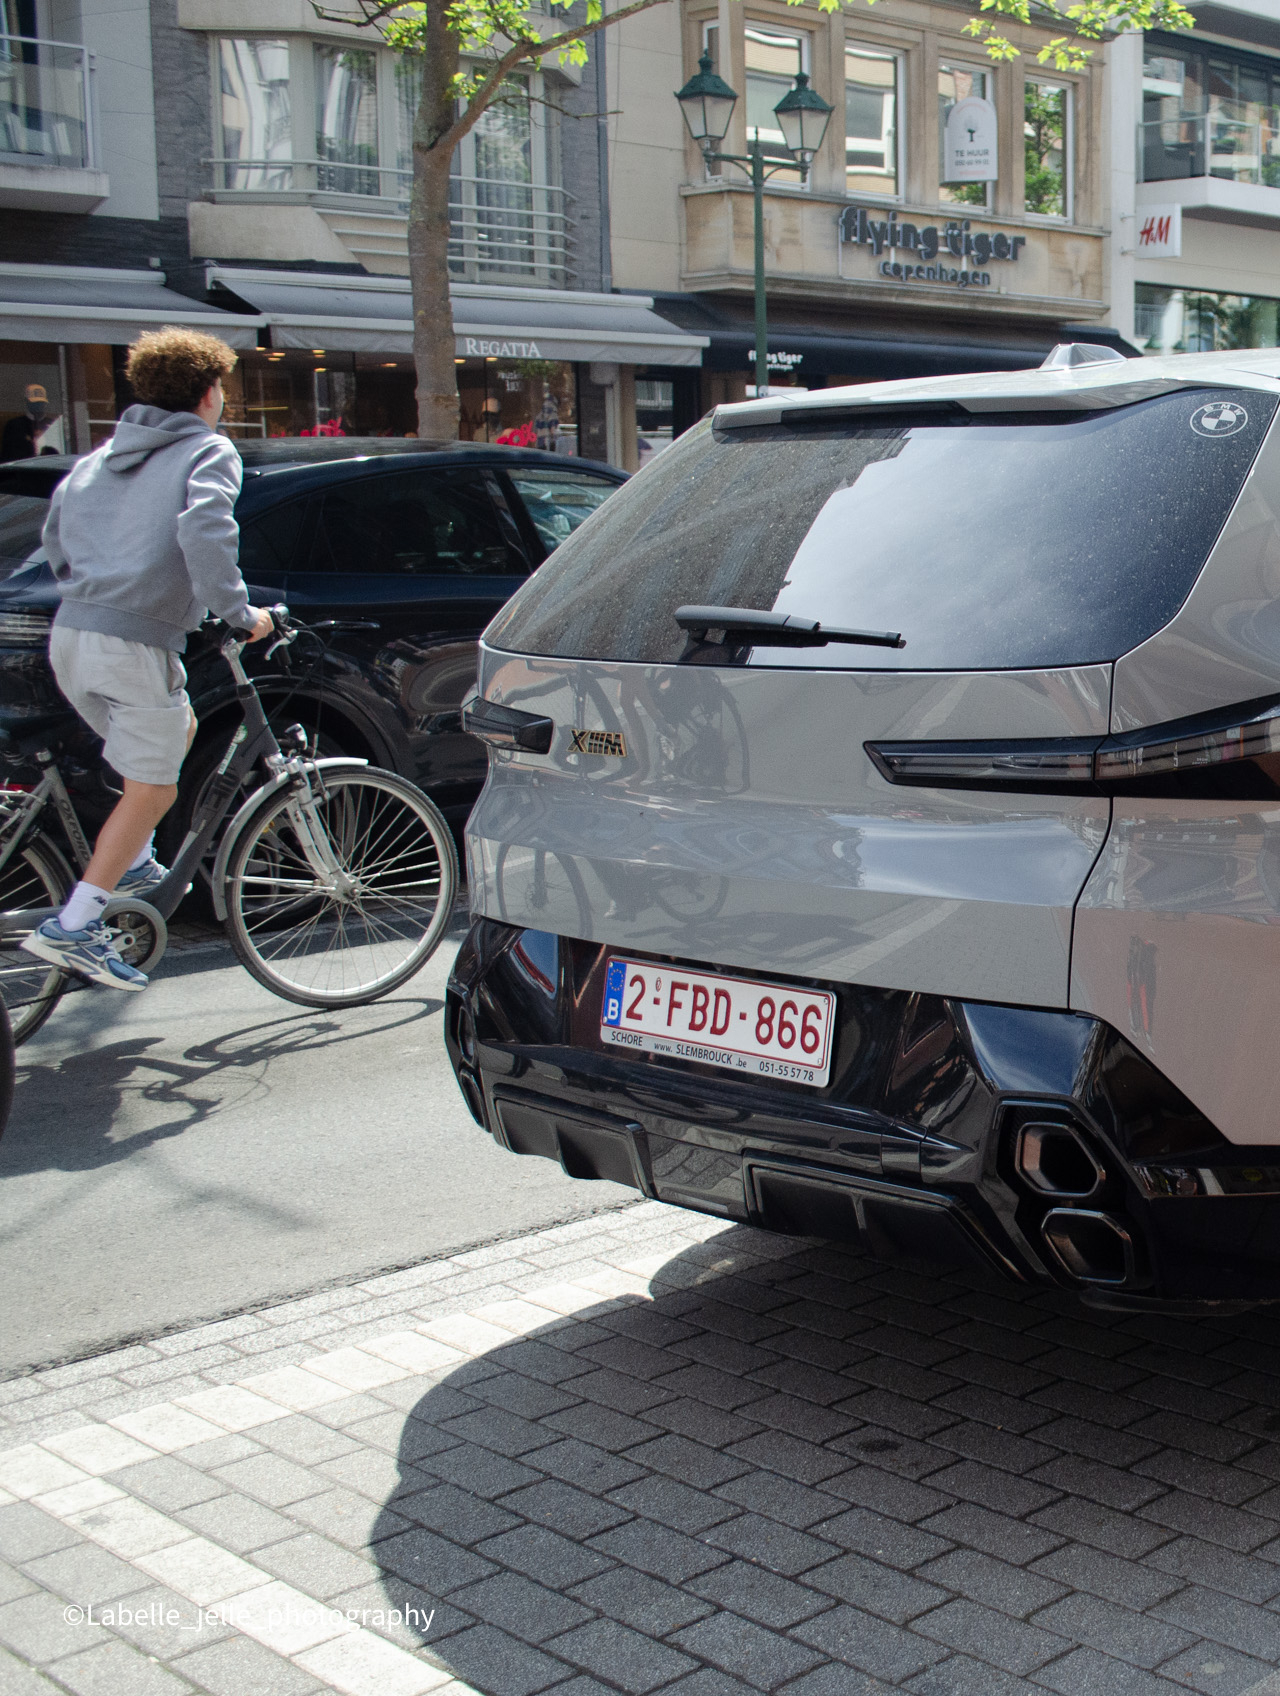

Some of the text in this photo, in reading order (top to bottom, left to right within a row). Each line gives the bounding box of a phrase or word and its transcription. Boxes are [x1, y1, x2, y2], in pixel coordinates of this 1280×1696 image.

[839, 205, 1026, 266] flying tiger
[1139, 215, 1171, 246] H&M
[880, 260, 991, 287] copenhagen
[778, 351, 803, 365] tiger
[1203, 403, 1244, 415] BMW
[607, 998, 619, 1020] B
[625, 974, 823, 1054] 2-FBD-866
[611, 1031, 815, 1082] SCHORE www. SLEMBROUCK .be 051-55 57 78
